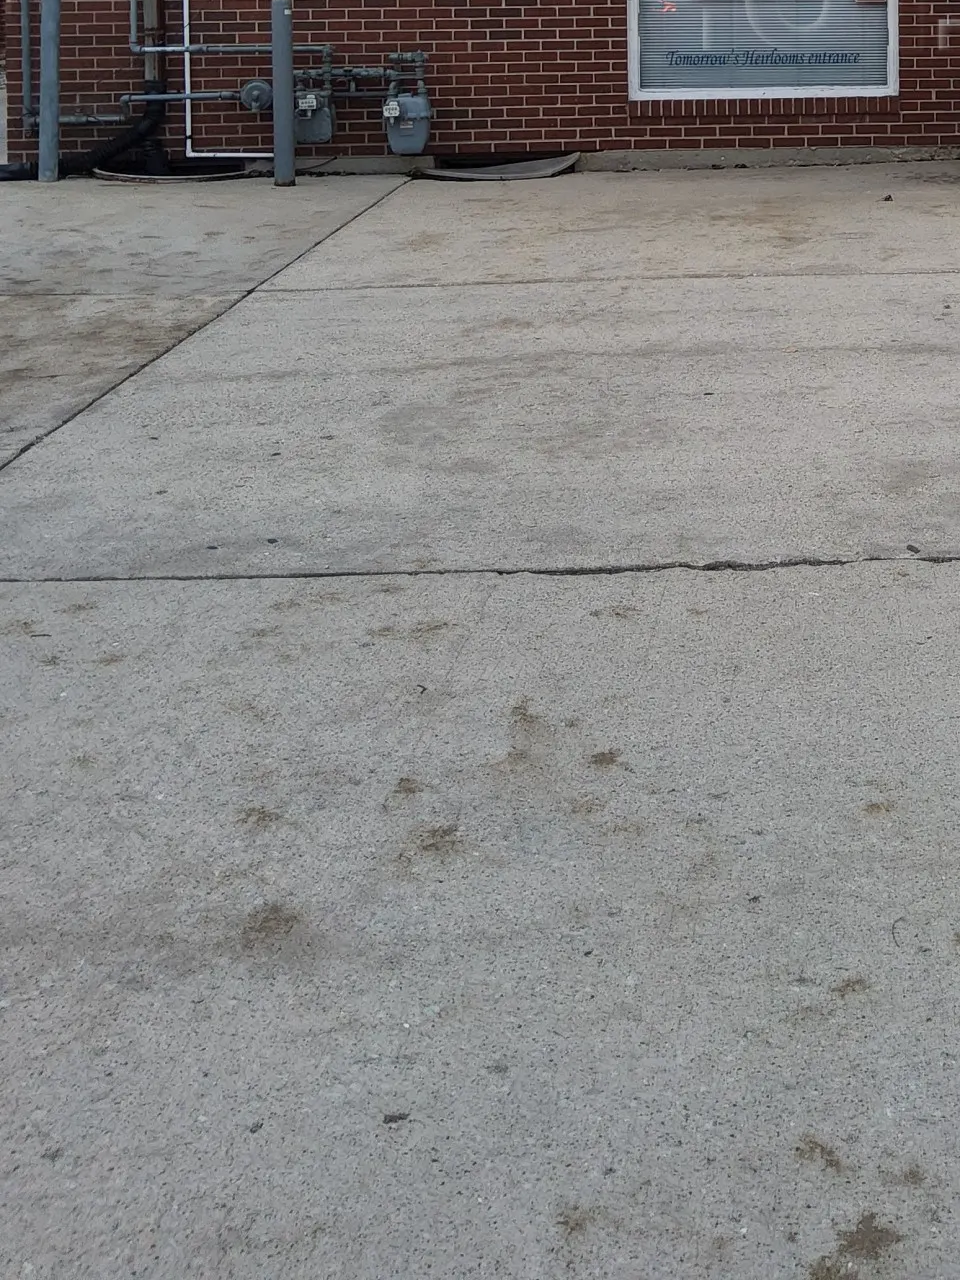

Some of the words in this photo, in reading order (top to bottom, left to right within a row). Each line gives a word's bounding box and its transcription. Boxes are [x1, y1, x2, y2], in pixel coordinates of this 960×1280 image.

[666, 48, 740, 66] Tomorrow's
[742, 48, 804, 66] Heirlooms
[807, 51, 860, 65] entrance
